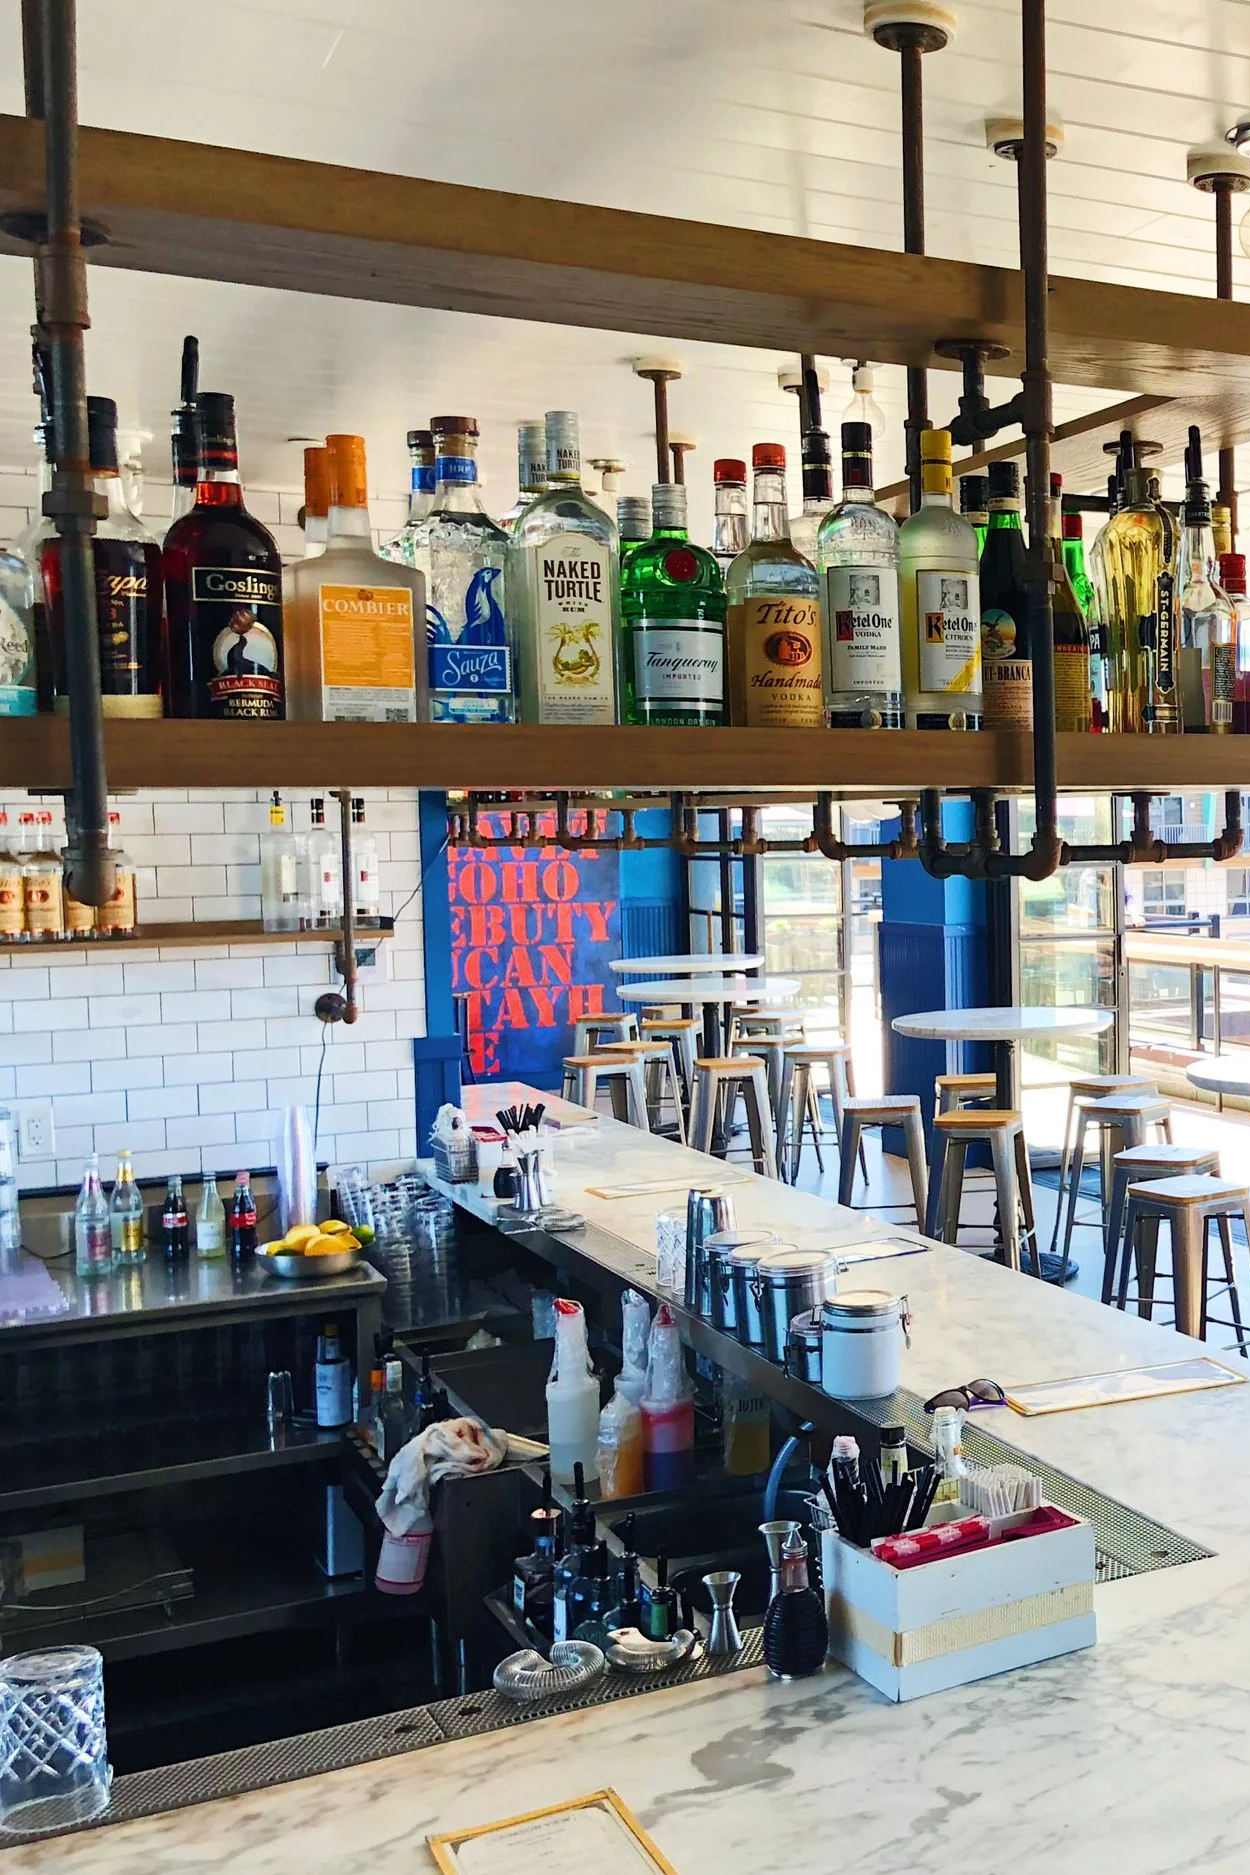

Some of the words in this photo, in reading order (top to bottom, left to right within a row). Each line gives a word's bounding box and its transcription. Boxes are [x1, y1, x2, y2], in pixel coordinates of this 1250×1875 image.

[543, 560, 601, 579] NAKED
[544, 580, 602, 603] TURTLE
[323, 599, 408, 616] COMBIER
[757, 601, 816, 626] Tito's
[837, 611, 871, 641] Ketel
[872, 613, 892, 629] One
[927, 615, 960, 641] Ketel
[1160, 590, 1169, 672] ST-GERMAIN
[443, 651, 502, 686] Sauza
[647, 652, 718, 673] Tanqueray
[229, 699, 274, 708] BERMUDA
[772, 693, 812, 701] VODKA
[651, 718, 685, 726] LONDON
